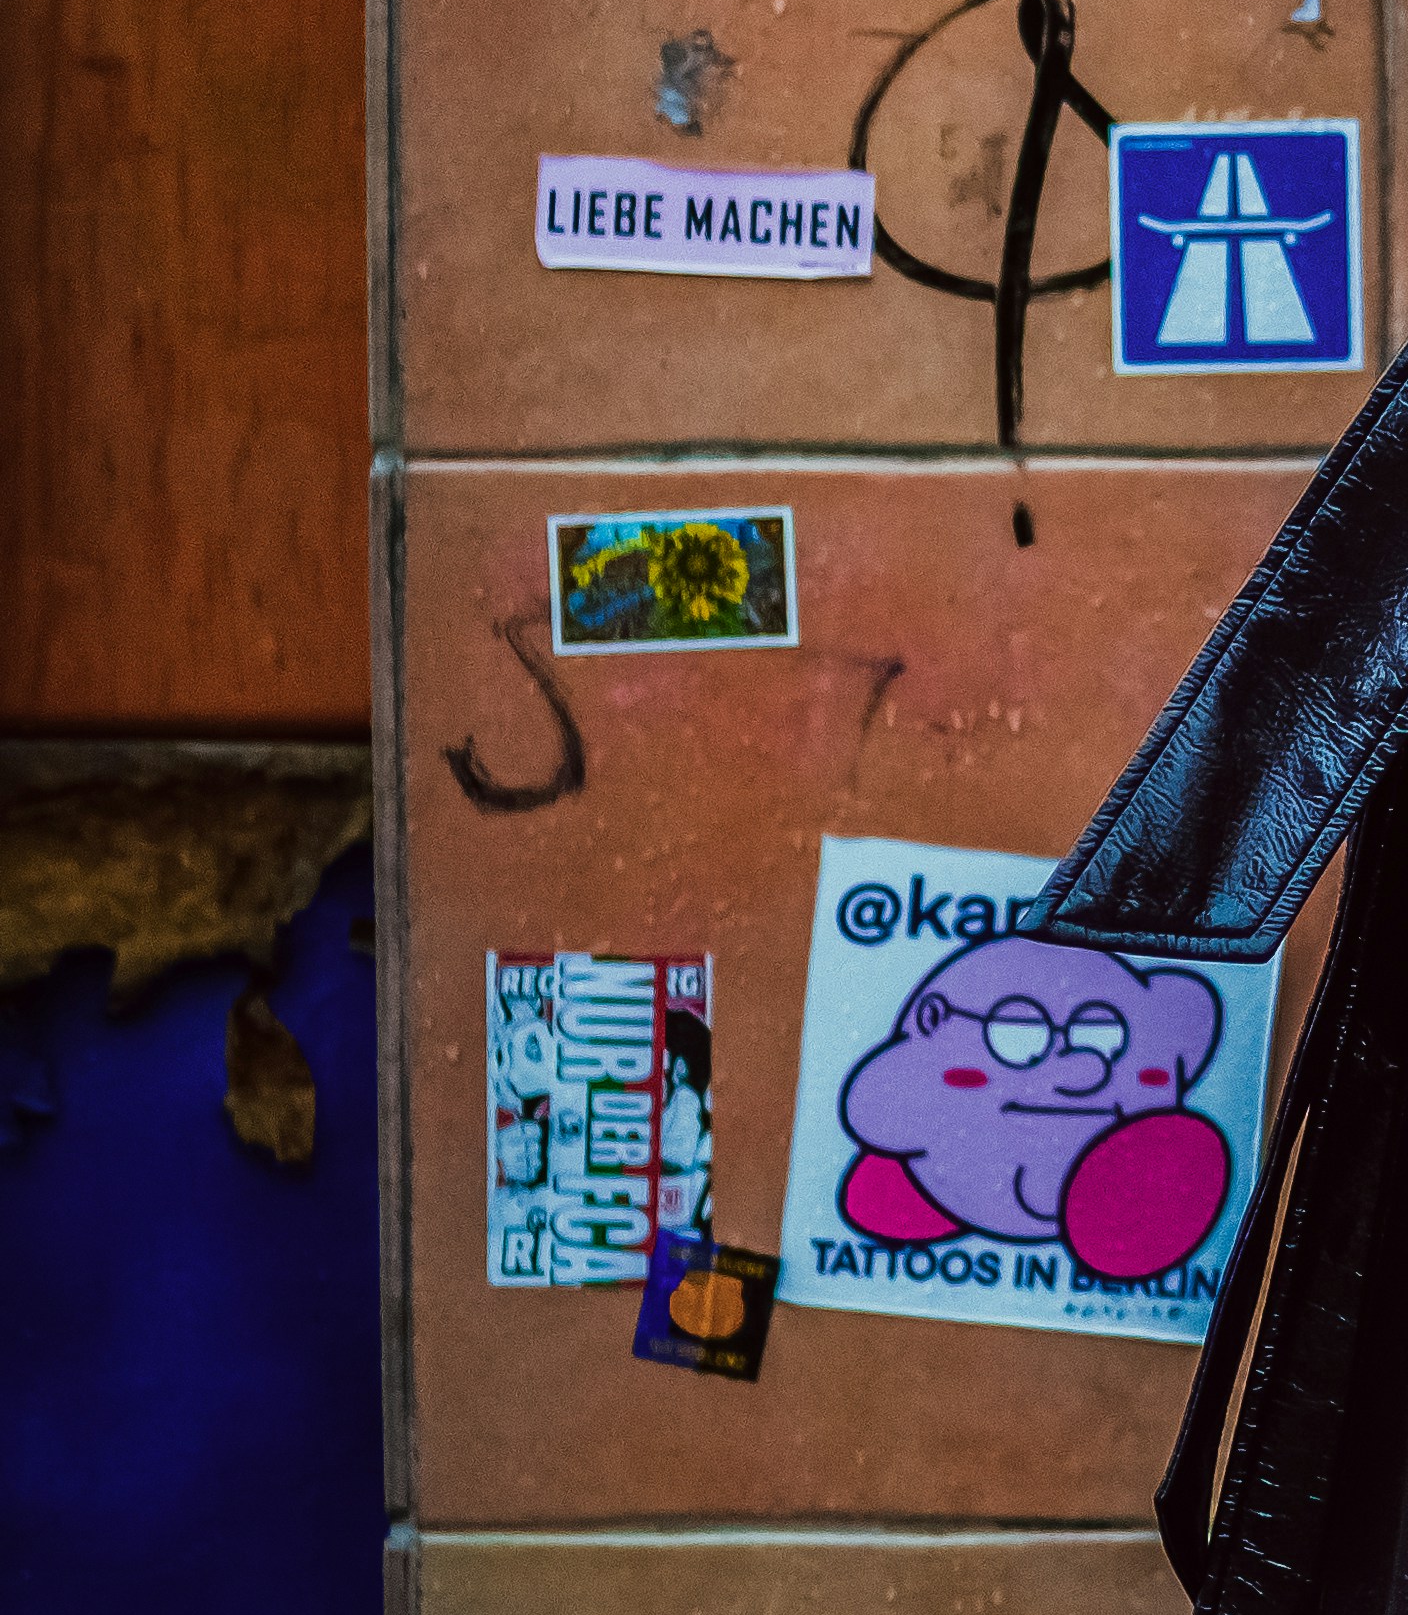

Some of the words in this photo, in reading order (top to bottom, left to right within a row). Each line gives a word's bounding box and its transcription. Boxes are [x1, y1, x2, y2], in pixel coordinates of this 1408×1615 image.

[546, 188, 664, 241] LIEBE
[684, 195, 863, 253] MACHEN
[556, 959, 656, 1085] NUR
[587, 1089, 653, 1167] DER
[553, 1174, 650, 1284] FCA
[809, 1236, 1001, 1286] TATTOOS
[1013, 1253, 1057, 1291] IN
